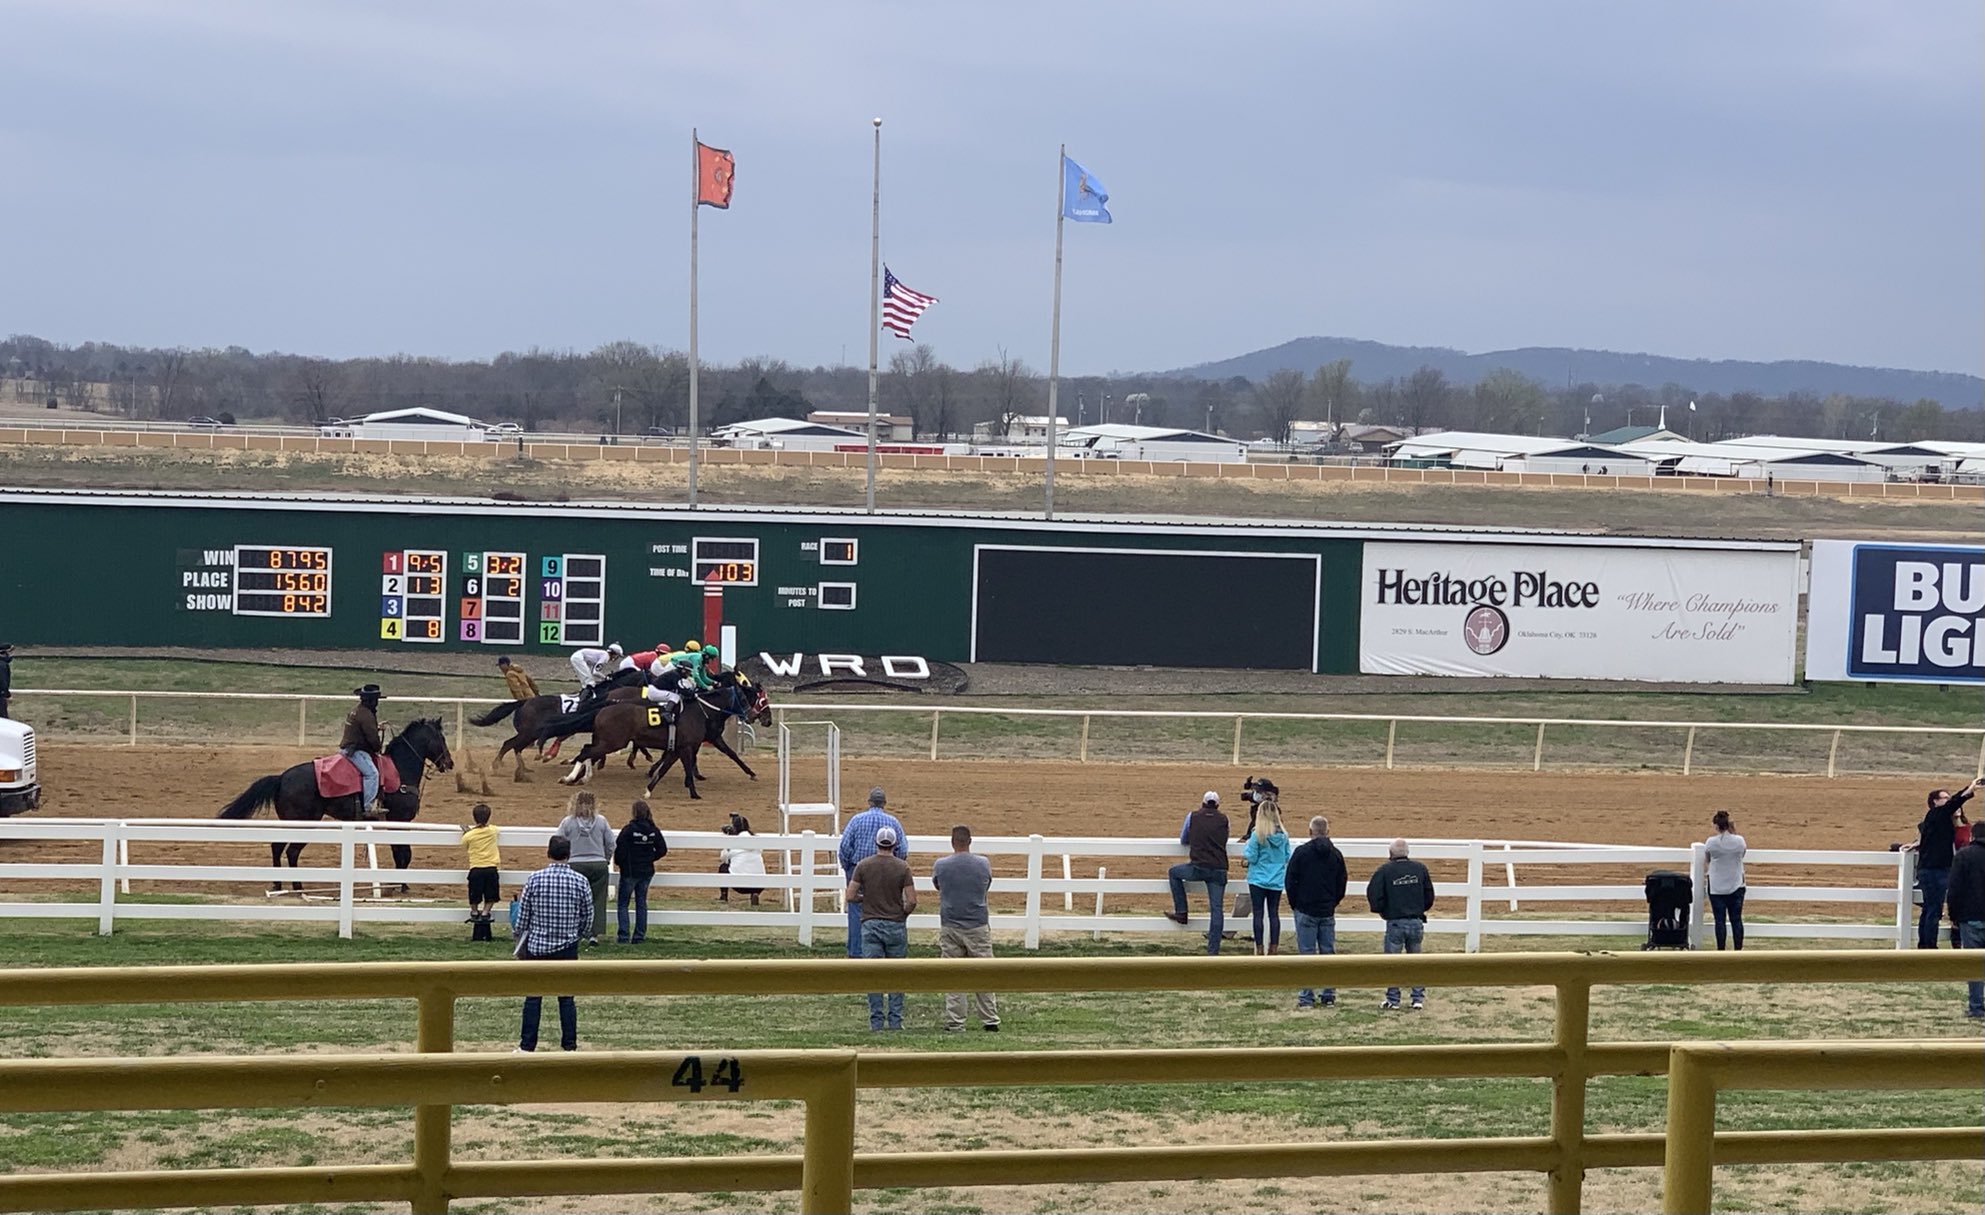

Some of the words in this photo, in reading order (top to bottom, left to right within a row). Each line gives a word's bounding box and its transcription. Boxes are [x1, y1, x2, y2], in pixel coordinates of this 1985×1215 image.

[652, 544, 670, 554] POST
[671, 544, 688, 554] TIME
[800, 541, 818, 551] RACE
[846, 543, 852, 560] 1
[203, 550, 235, 566] WIN
[270, 550, 326, 570] 8795
[389, 554, 397, 570] 1
[467, 554, 478, 570] 5
[547, 560, 558, 574] 9
[649, 567, 666, 577] TIME
[666, 568, 676, 577] OF
[182, 571, 229, 588] PLACE
[276, 573, 325, 591] 1560
[388, 578, 398, 592] 2
[467, 579, 478, 594] 6
[508, 579, 519, 596] 2
[543, 582, 561, 597] 10
[777, 586, 807, 596] MINUTES
[808, 587, 818, 596] TO
[1373, 568, 1507, 608] Heritage
[1511, 570, 1600, 608] Place
[186, 594, 232, 610] SHOW
[284, 595, 325, 612] 842
[387, 599, 398, 615] 3
[467, 602, 477, 616] 7
[787, 598, 806, 607] POST
[1685, 592, 1780, 620] Champions
[543, 603, 559, 619] 11
[386, 621, 397, 636] 4
[428, 620, 439, 638] 8
[466, 623, 476, 638] 8
[542, 625, 559, 641] 12
[1415, 628, 1448, 636] MacArthur
[1517, 630, 1548, 638] Oklahoma
[1564, 631, 1576, 639] OK
[1651, 620, 1690, 640] Are
[759, 651, 931, 680] WRD
[648, 707, 662, 727] 6
[671, 1055, 745, 1093] 44
